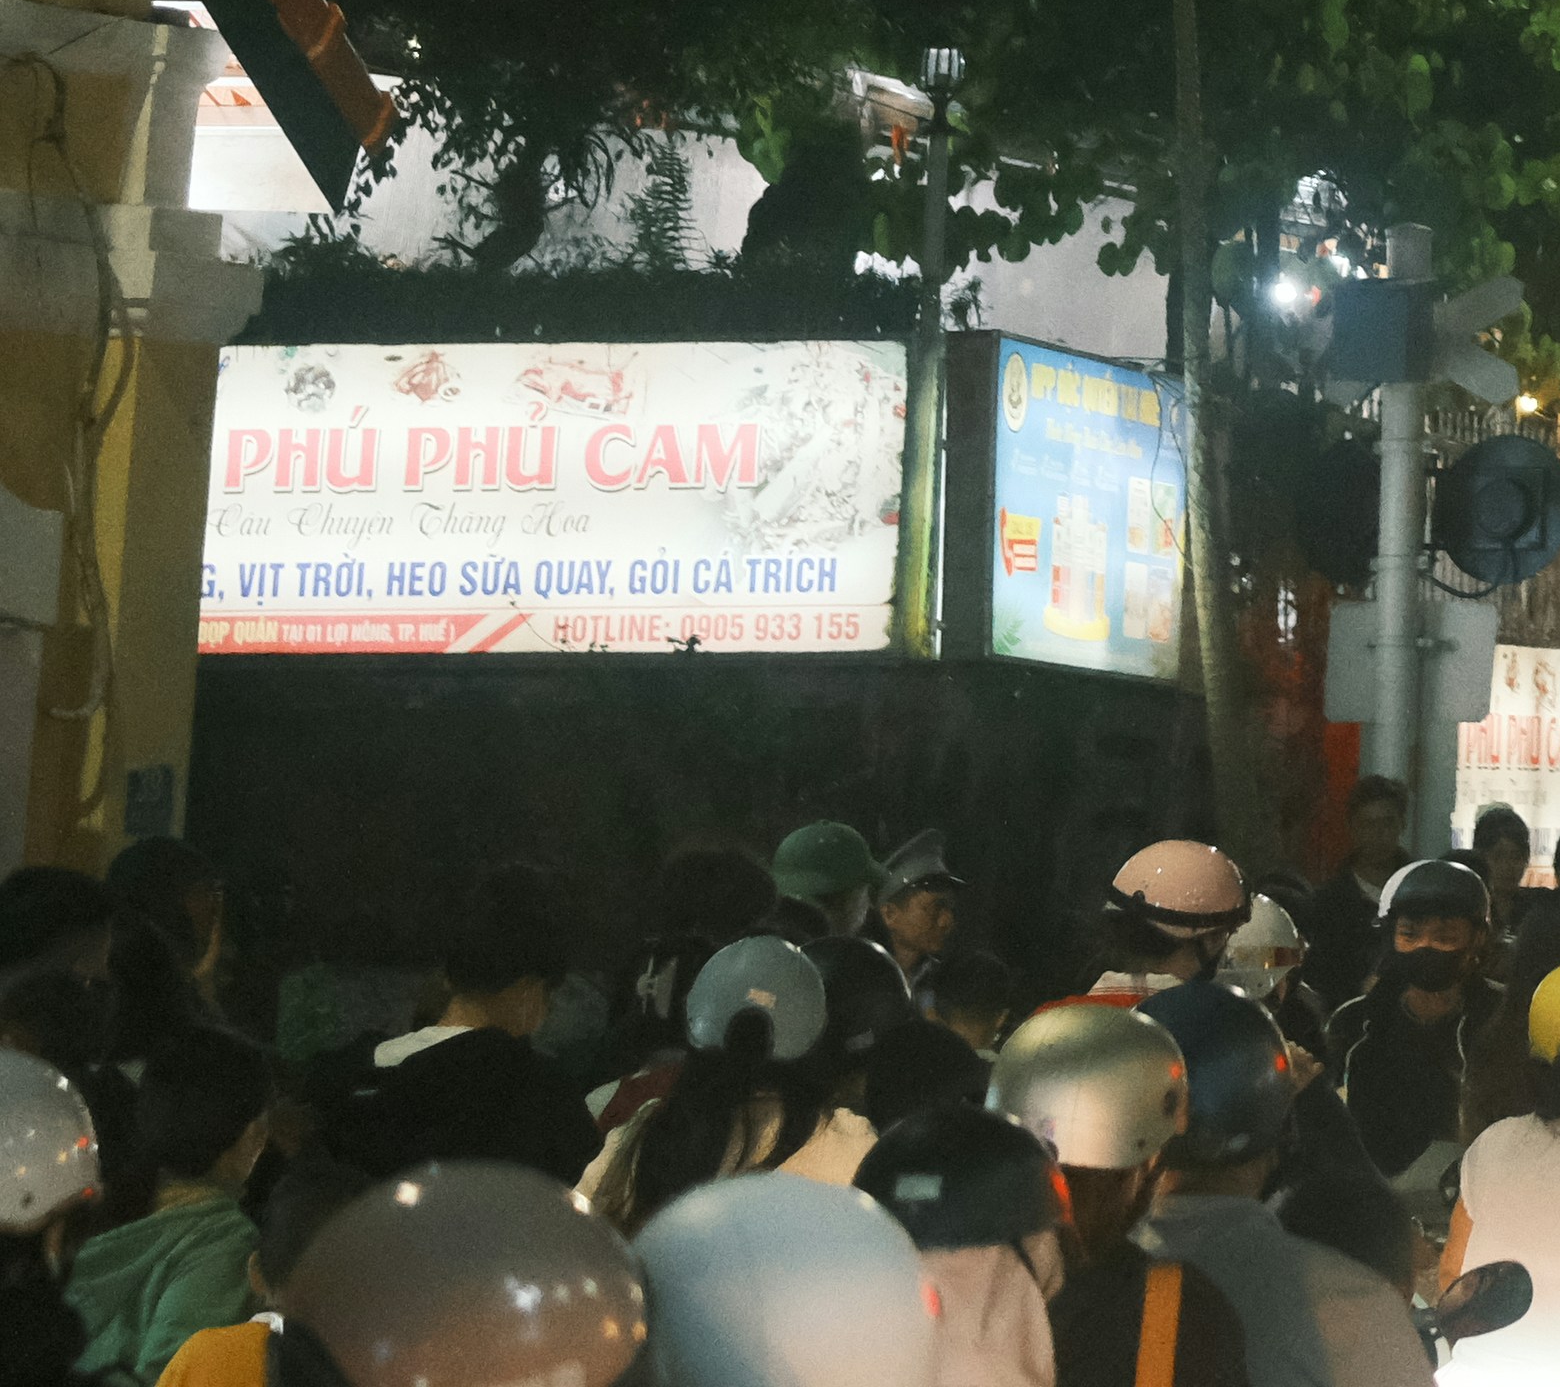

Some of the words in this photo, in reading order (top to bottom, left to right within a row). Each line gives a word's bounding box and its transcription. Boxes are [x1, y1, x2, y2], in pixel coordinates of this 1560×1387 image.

[222, 404, 381, 494] PHÚ
[402, 400, 559, 493] PHỦ
[584, 422, 761, 494] CAM
[521, 500, 591, 539] Hoa
[239, 562, 285, 607] VỊT
[295, 552, 373, 601] TRỜI,
[386, 561, 448, 597] HEO
[459, 554, 522, 598] SỮA
[534, 559, 616, 600] QUAY,
[628, 546, 681, 596] GỎI
[692, 549, 733, 595] CÁ
[746, 549, 838, 595] TRÍCH
[552, 613, 671, 644] HOTLINE:
[679, 612, 745, 643] 0905
[754, 612, 802, 642] 933
[813, 611, 861, 642] 155
